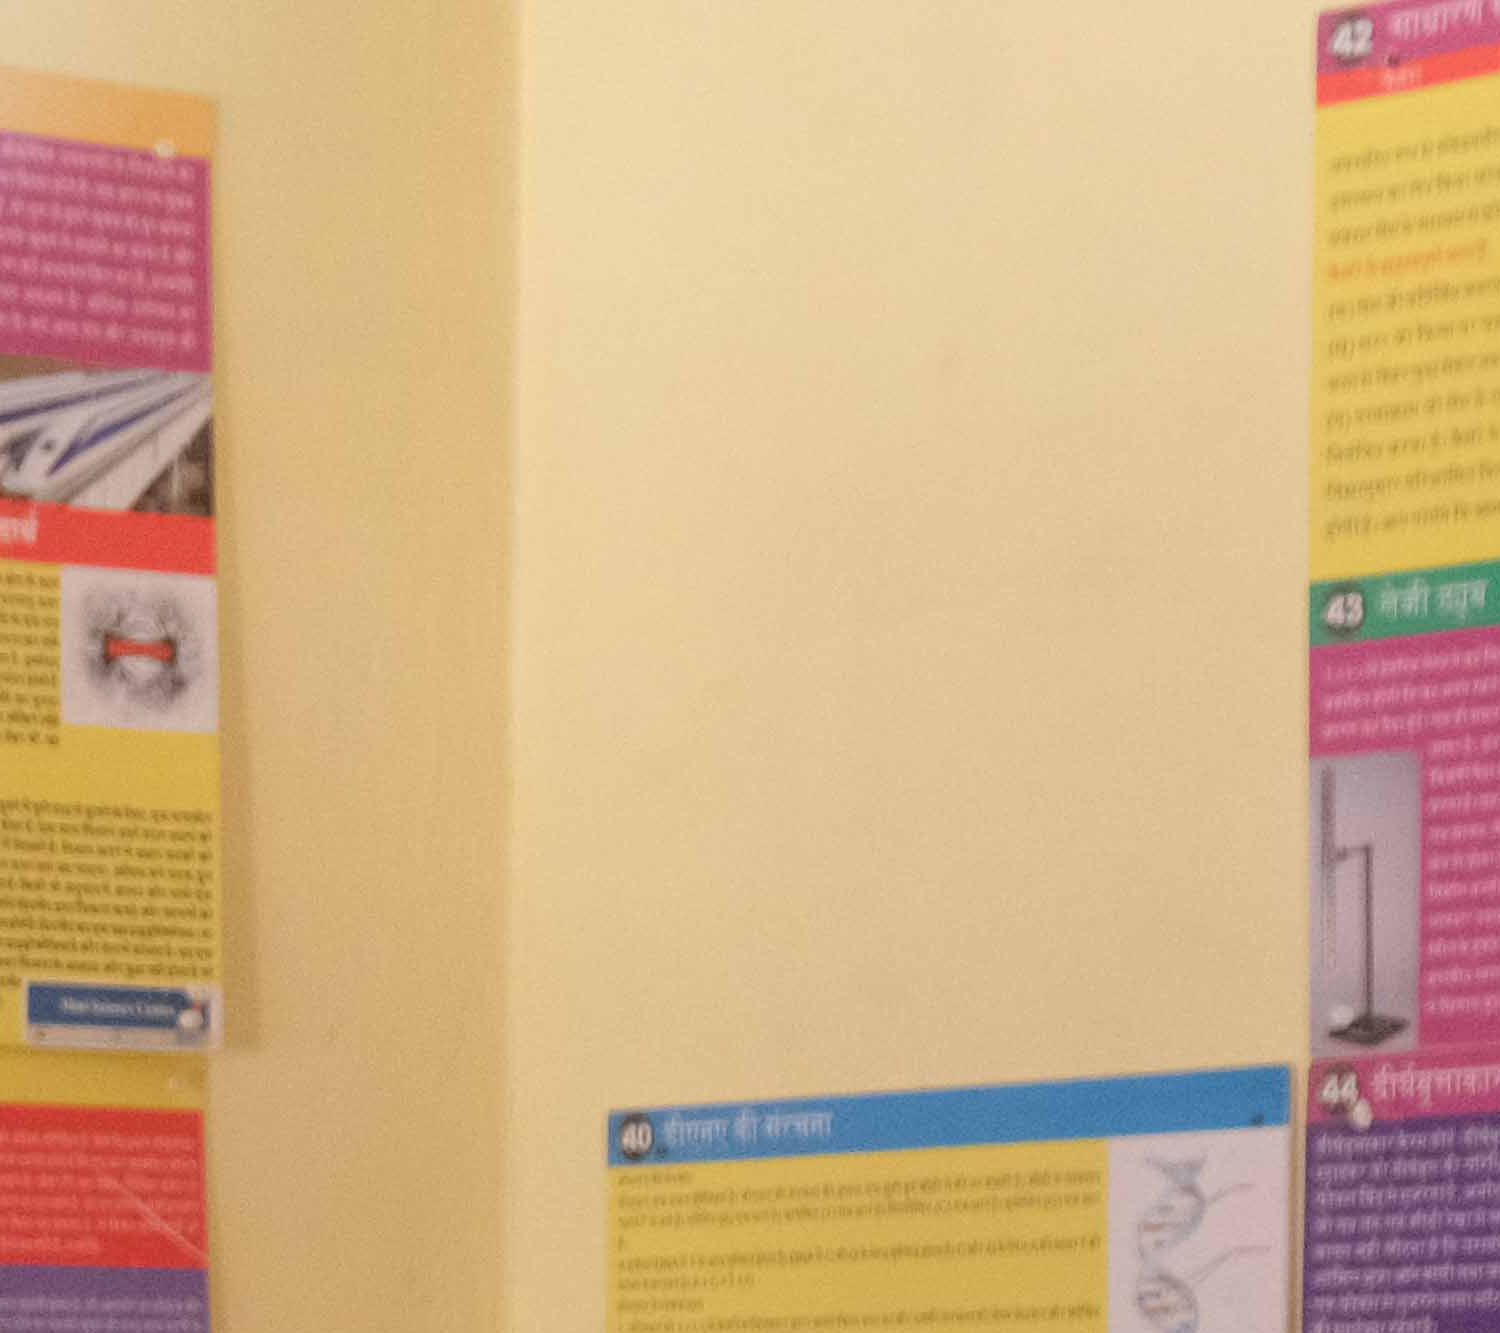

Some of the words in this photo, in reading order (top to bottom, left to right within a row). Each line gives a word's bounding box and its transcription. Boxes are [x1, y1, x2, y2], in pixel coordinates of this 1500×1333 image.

[1325, 592, 1363, 623] 43
[1323, 1073, 1357, 1102] 44
[622, 1123, 652, 1150] 40
